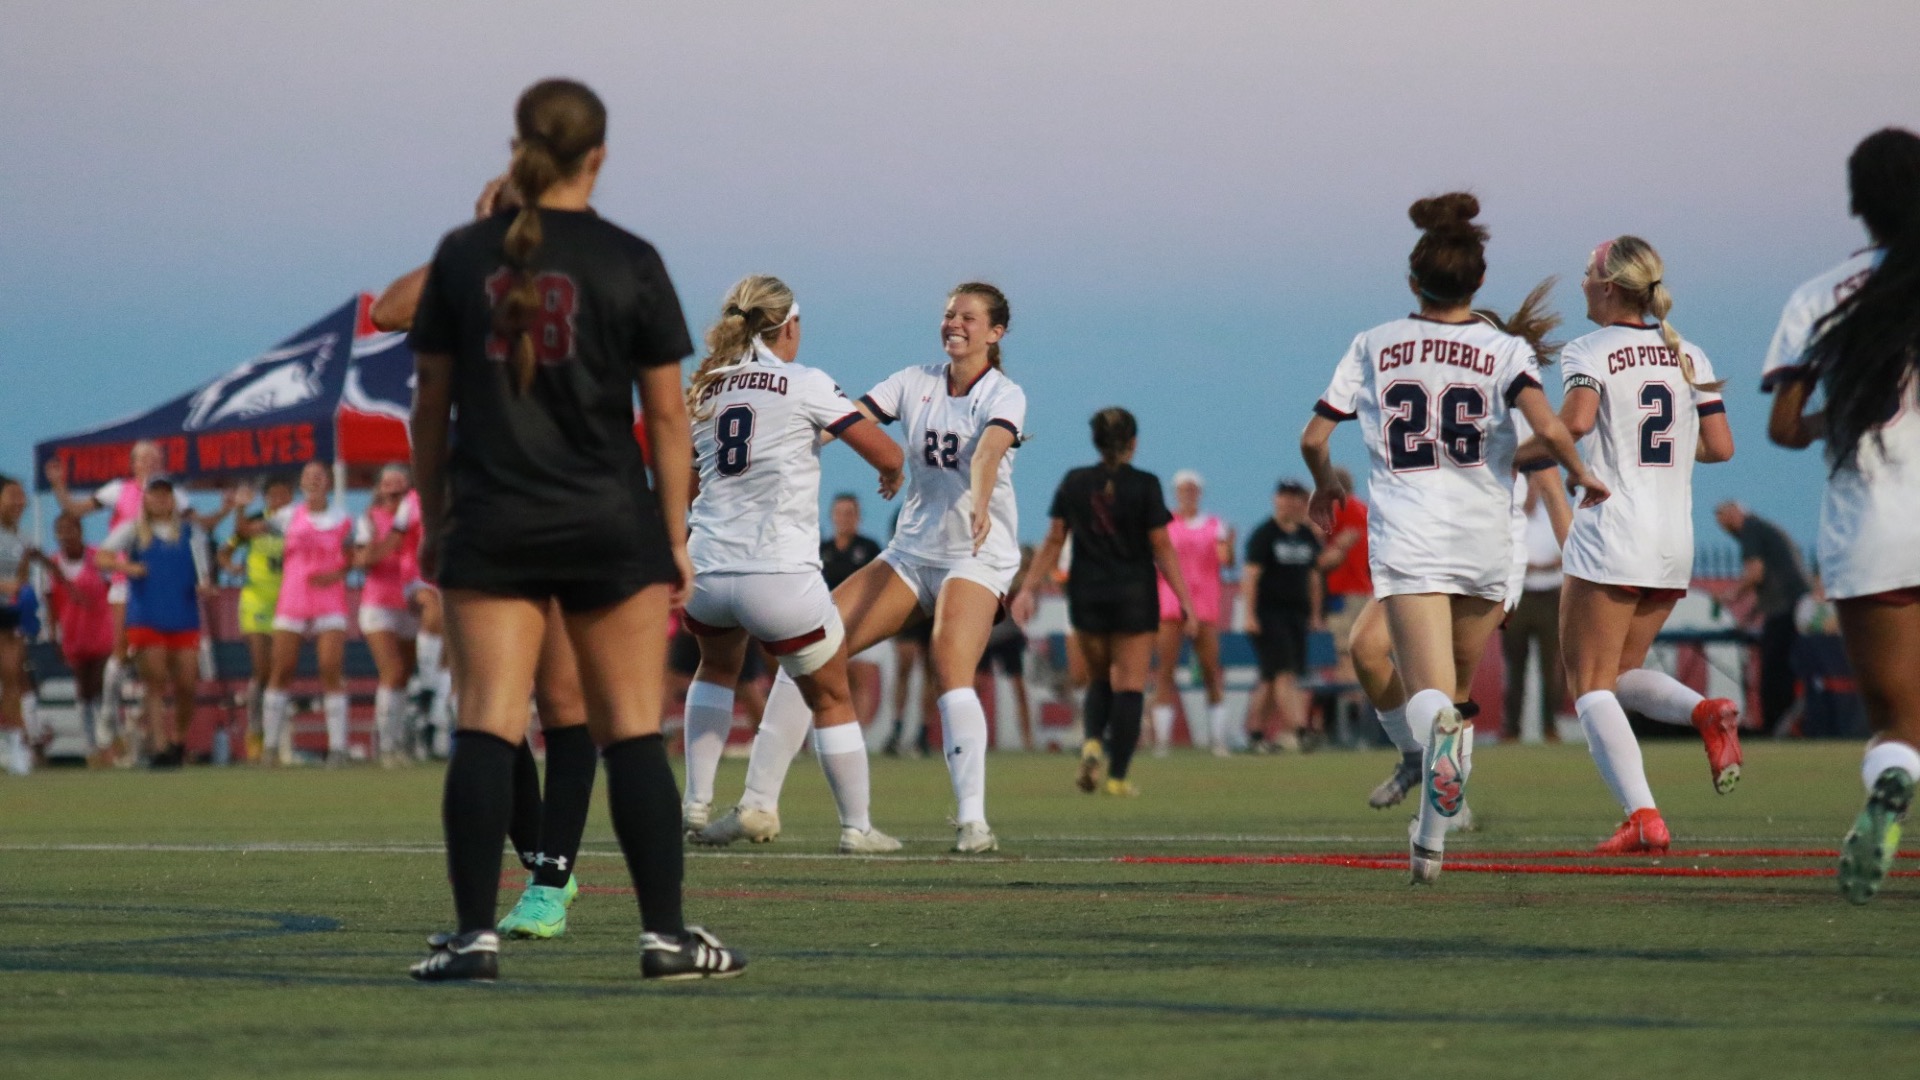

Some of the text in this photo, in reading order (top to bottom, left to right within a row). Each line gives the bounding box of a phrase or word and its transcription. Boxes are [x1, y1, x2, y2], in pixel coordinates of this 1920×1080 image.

[1379, 339, 1496, 376] CSU PUEBLO
[1608, 346, 1695, 375] CSU PUEBO
[701, 372, 788, 402] SU PUEBLO
[714, 403, 757, 477] 8
[925, 428, 960, 470] 22
[1381, 379, 1488, 474] 26
[1638, 380, 1675, 467] 2
[57, 423, 314, 485] THUNR WOLVES
